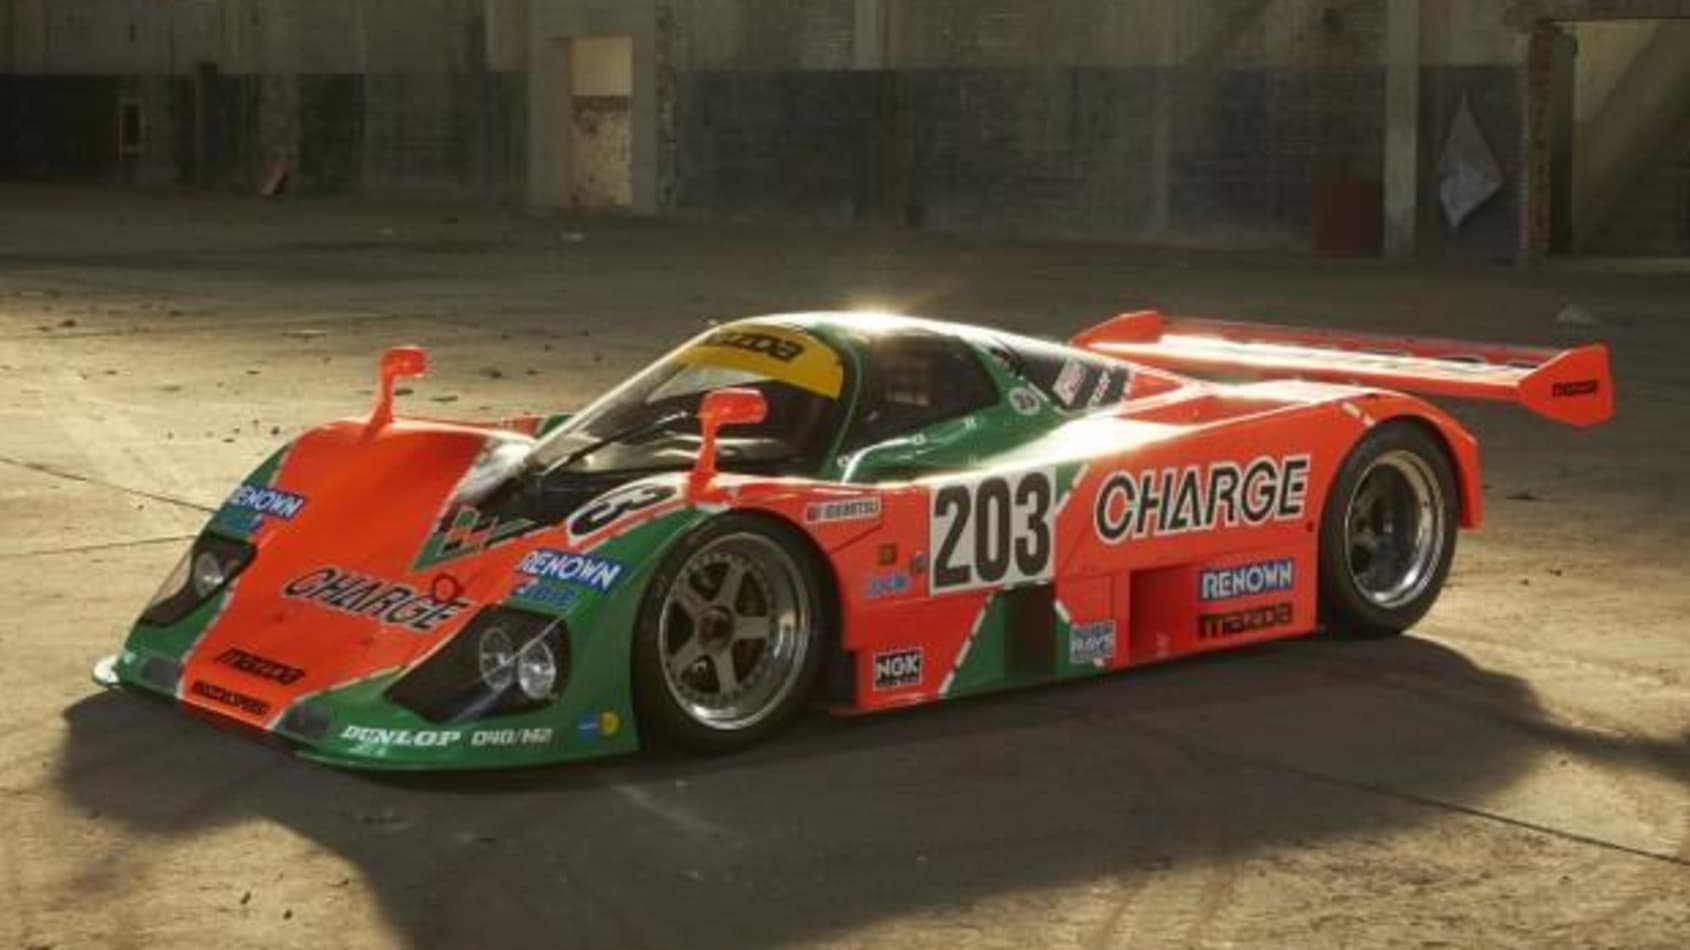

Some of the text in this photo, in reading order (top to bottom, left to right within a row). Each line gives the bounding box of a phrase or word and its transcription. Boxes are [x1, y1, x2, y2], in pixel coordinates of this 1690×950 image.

[1095, 455, 1310, 545] CHARGE
[934, 472, 1050, 588] 203
[518, 550, 622, 590] RENOWN
[1202, 560, 1292, 599] RENOWN
[282, 566, 468, 632] CHARGE
[875, 653, 918, 679] NGK
[340, 725, 461, 747] DUNLOP
